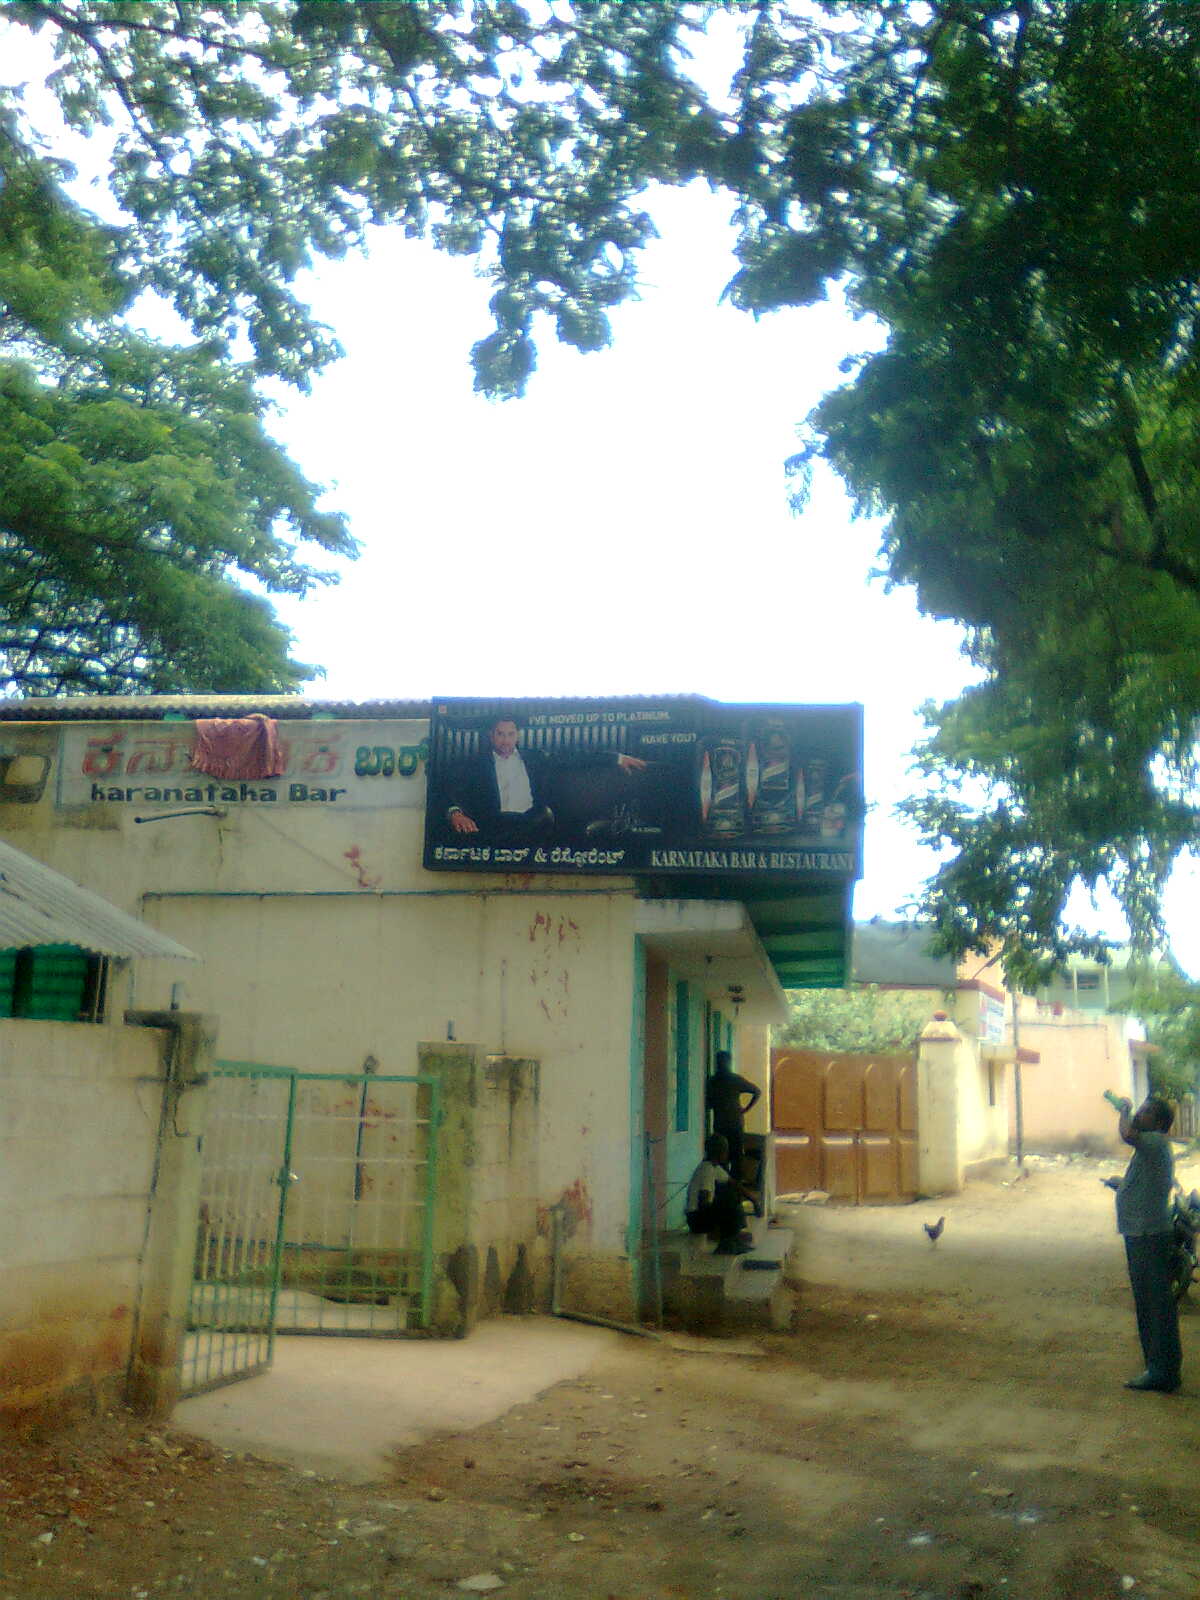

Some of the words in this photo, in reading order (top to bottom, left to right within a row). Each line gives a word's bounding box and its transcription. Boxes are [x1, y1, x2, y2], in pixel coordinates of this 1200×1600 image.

[289, 783, 347, 802] Bar
[651, 850, 728, 868] KARNATAKA
[731, 852, 756, 869] BAR
